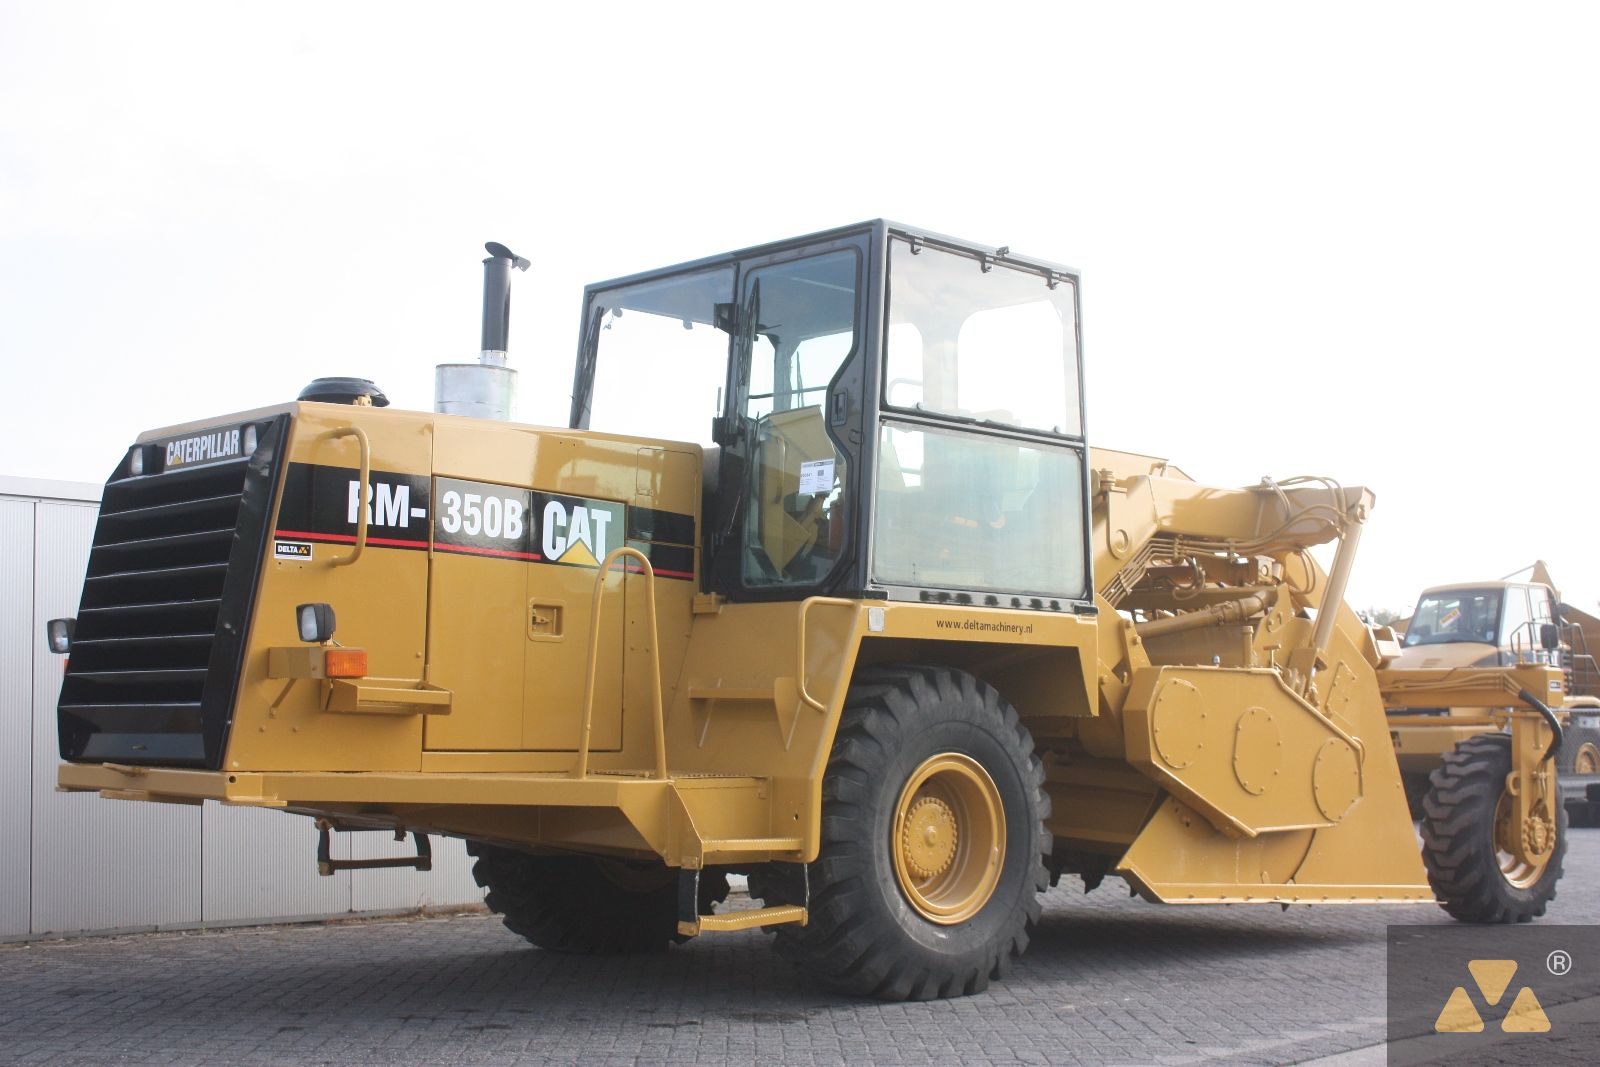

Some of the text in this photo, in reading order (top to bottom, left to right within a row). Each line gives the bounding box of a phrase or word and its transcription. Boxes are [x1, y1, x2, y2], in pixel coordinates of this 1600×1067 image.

[166, 429, 240, 466] CATERPILLAR
[441, 490, 523, 540] 350B
[542, 500, 612, 566] CAT
[277, 545, 298, 553] DELTA
[936, 619, 1033, 635] www.deltamachinery.nl
